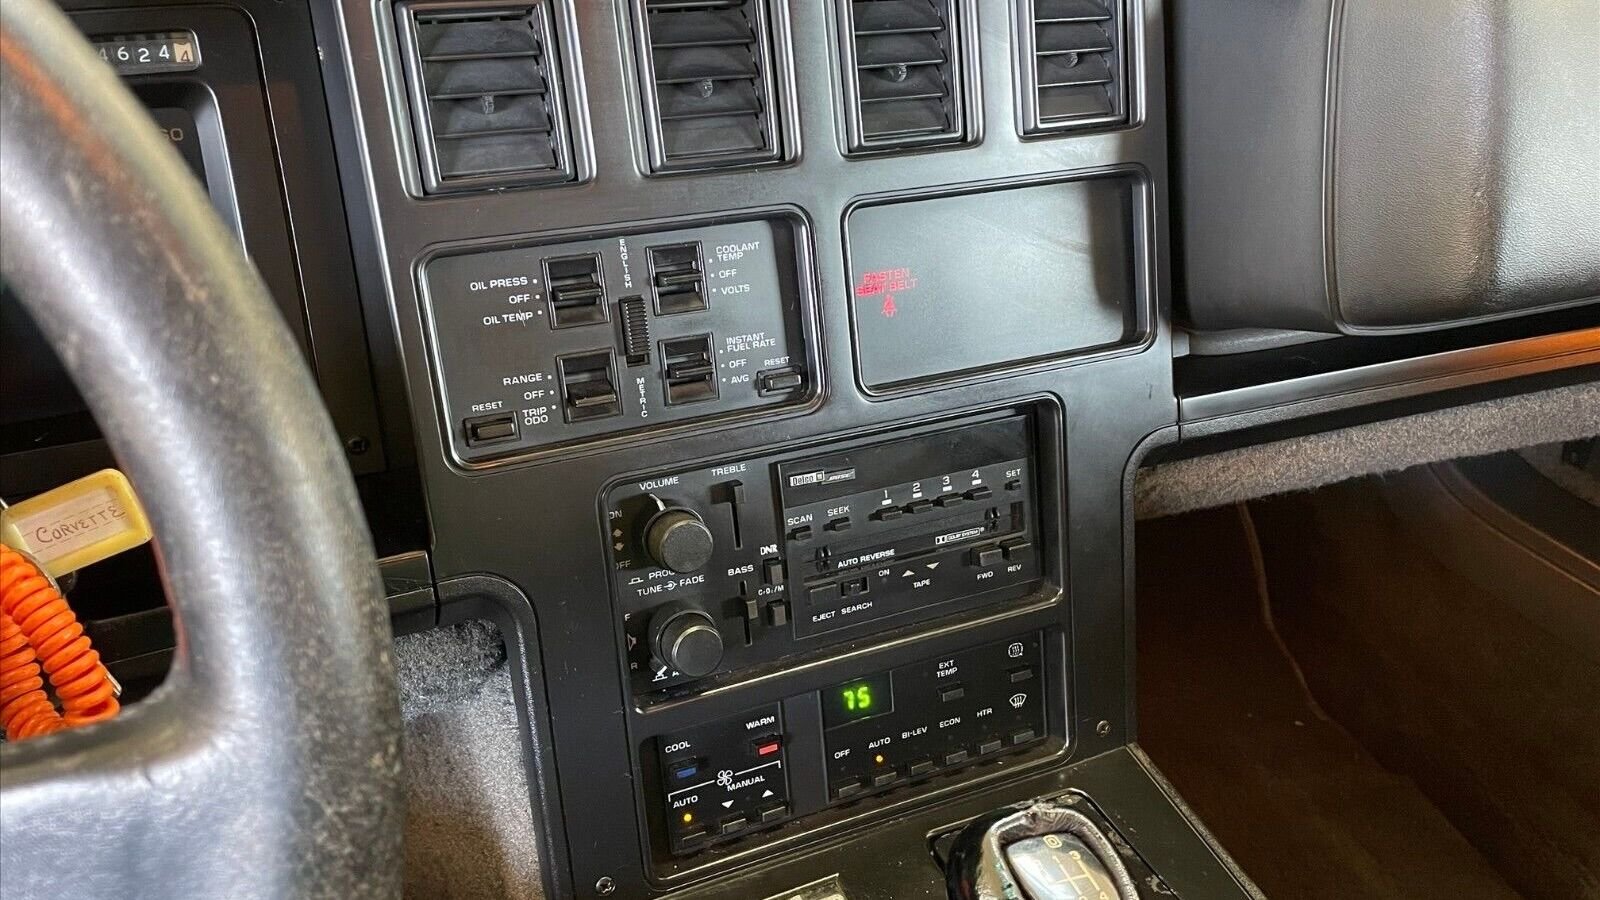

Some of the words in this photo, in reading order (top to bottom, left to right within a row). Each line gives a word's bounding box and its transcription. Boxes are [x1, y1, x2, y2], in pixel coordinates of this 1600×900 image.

[716, 241, 760, 254] COOLANT
[717, 251, 744, 262] TEMP
[619, 239, 632, 288] ENGLISH
[719, 269, 737, 279] OFF
[470, 281, 488, 291] OIL
[489, 276, 528, 289] PRESS
[721, 284, 750, 295] VOLTS
[889, 278, 918, 292] BELT
[509, 294, 530, 304] OFF
[483, 315, 501, 326] OIL
[501, 311, 534, 324] TEMP
[726, 332, 766, 345] INSTANT
[727, 341, 752, 352] FUEL
[752, 338, 776, 349] RATE
[729, 359, 747, 369] OFF
[764, 356, 790, 366] RESET
[503, 373, 543, 386] RANGE
[731, 374, 750, 384] AVG
[524, 390, 545, 400] OFF
[637, 377, 648, 418] METRIC
[472, 401, 503, 412] RESET
[522, 407, 547, 418] TRIP
[524, 415, 548, 426] ODO
[711, 464, 746, 476] TREBLE
[971, 469, 980, 479] 4
[1005, 468, 1021, 478] SET
[639, 476, 679, 491] VOLUME
[942, 476, 951, 486] 3
[912, 483, 922, 493] 2
[827, 506, 850, 517] SEEK
[36, 505, 126, 543] CORVETTE
[787, 513, 813, 526] SCAN
[838, 557, 858, 568] AUTO
[860, 548, 895, 563] REVERSE
[728, 564, 754, 576] BASS
[878, 569, 890, 577] ON
[1007, 563, 1022, 573] REV
[679, 575, 705, 586] FADE
[976, 571, 994, 581] FWD
[913, 578, 931, 589] TAPE
[637, 584, 663, 596] TUNE
[812, 611, 836, 623] EJECT
[841, 601, 873, 615] SEARCH
[938, 660, 955, 670] EXT
[936, 667, 958, 679] TEMP
[842, 686, 871, 711] 75
[976, 707, 993, 719] HTR
[745, 716, 775, 730] WARM
[939, 717, 961, 729] ECON
[901, 726, 928, 740] BI-LEV
[665, 741, 691, 755] COOL
[868, 737, 891, 750] AUTO
[834, 749, 850, 760] OFF
[726, 775, 766, 793] MANUAL
[673, 795, 698, 809] AUTO
